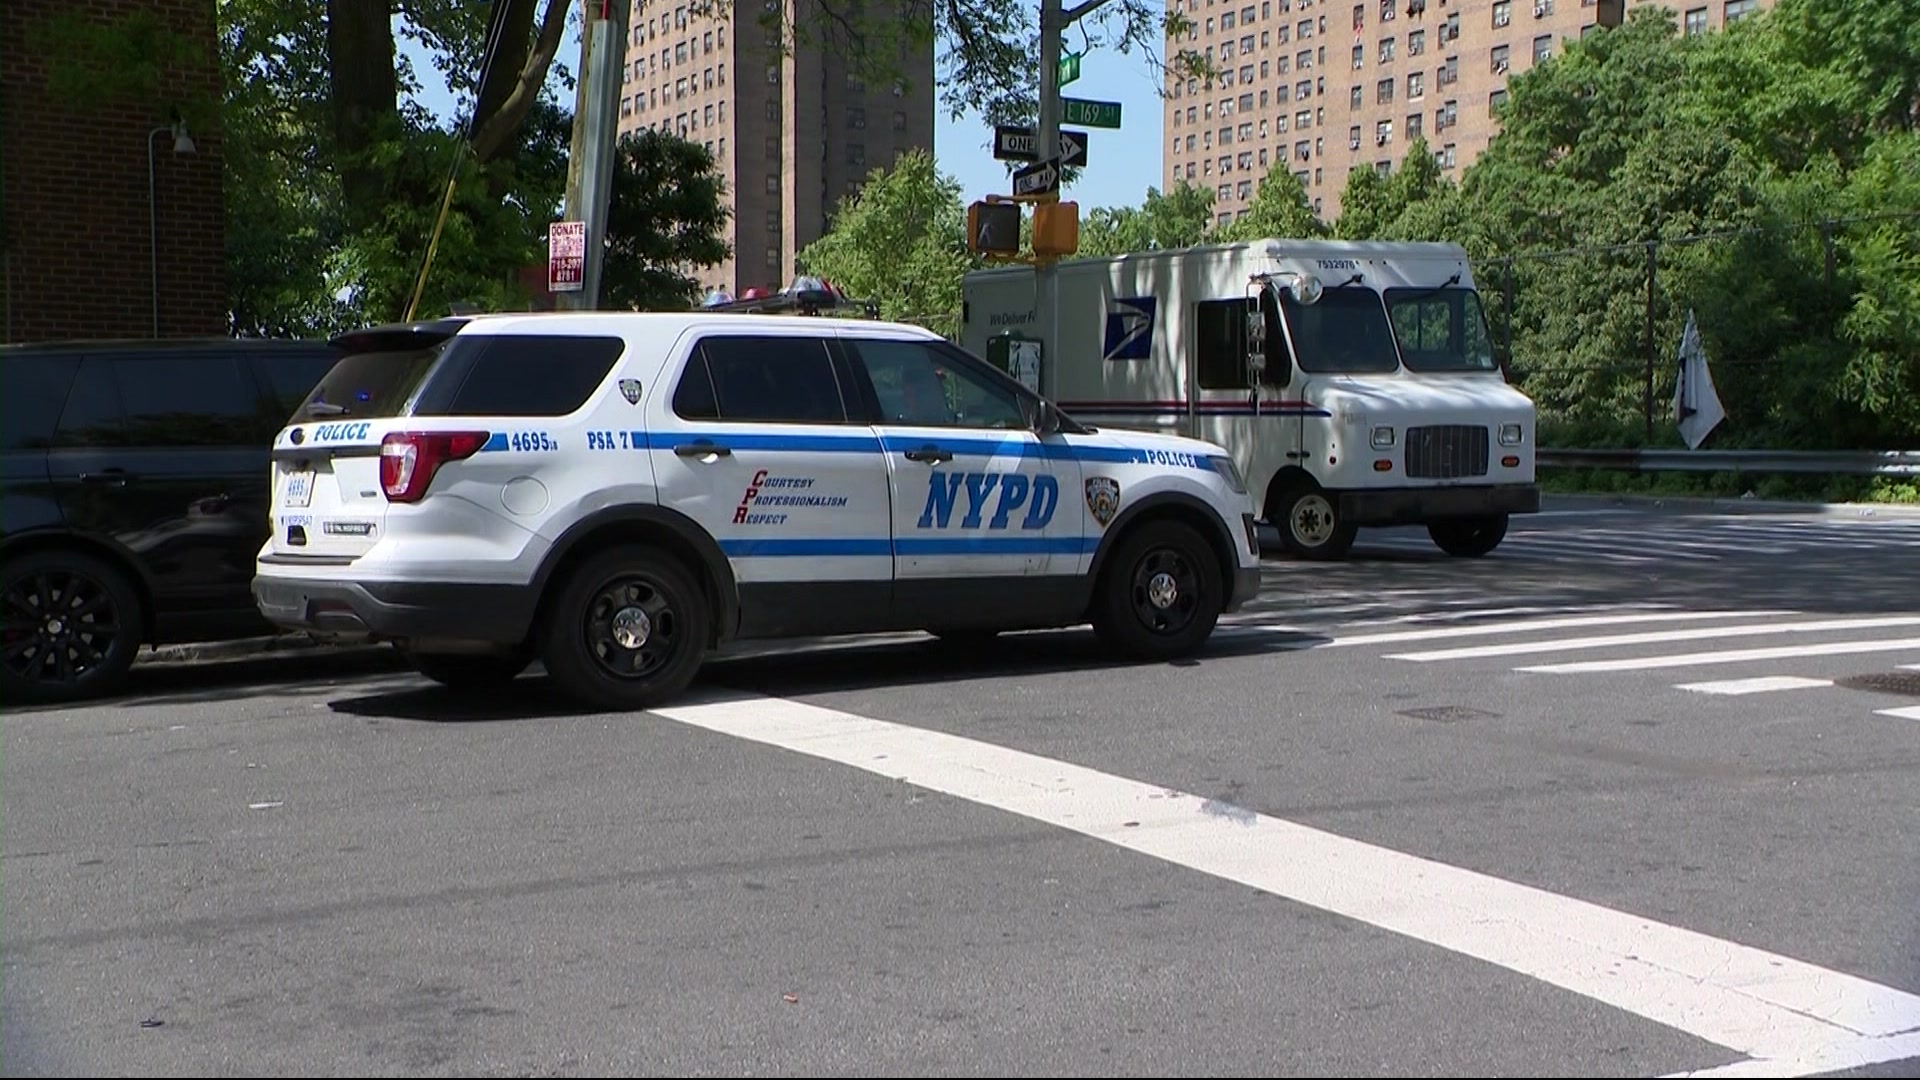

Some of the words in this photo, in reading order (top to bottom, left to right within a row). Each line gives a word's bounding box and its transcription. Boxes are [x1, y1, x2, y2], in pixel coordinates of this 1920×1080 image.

[1067, 102, 1075, 121] E
[1080, 103, 1099, 123] 169
[1105, 107, 1115, 117] ST
[1008, 137, 1035, 151] ONE
[1019, 175, 1033, 192] ONE
[1038, 170, 1052, 187] WAY
[552, 224, 584, 237] DONATE
[1002, 312, 1027, 326] Deliver
[314, 423, 371, 442] POLICE
[512, 431, 549, 452] 4695
[587, 431, 615, 450] PSA
[620, 431, 628, 450] 7
[1147, 449, 1195, 468] POLICE
[752, 470, 815, 488] COURTESY
[742, 488, 848, 507] PROFESSIONALISM
[917, 471, 1059, 530] NYPD
[732, 507, 787, 525] RESPECT
